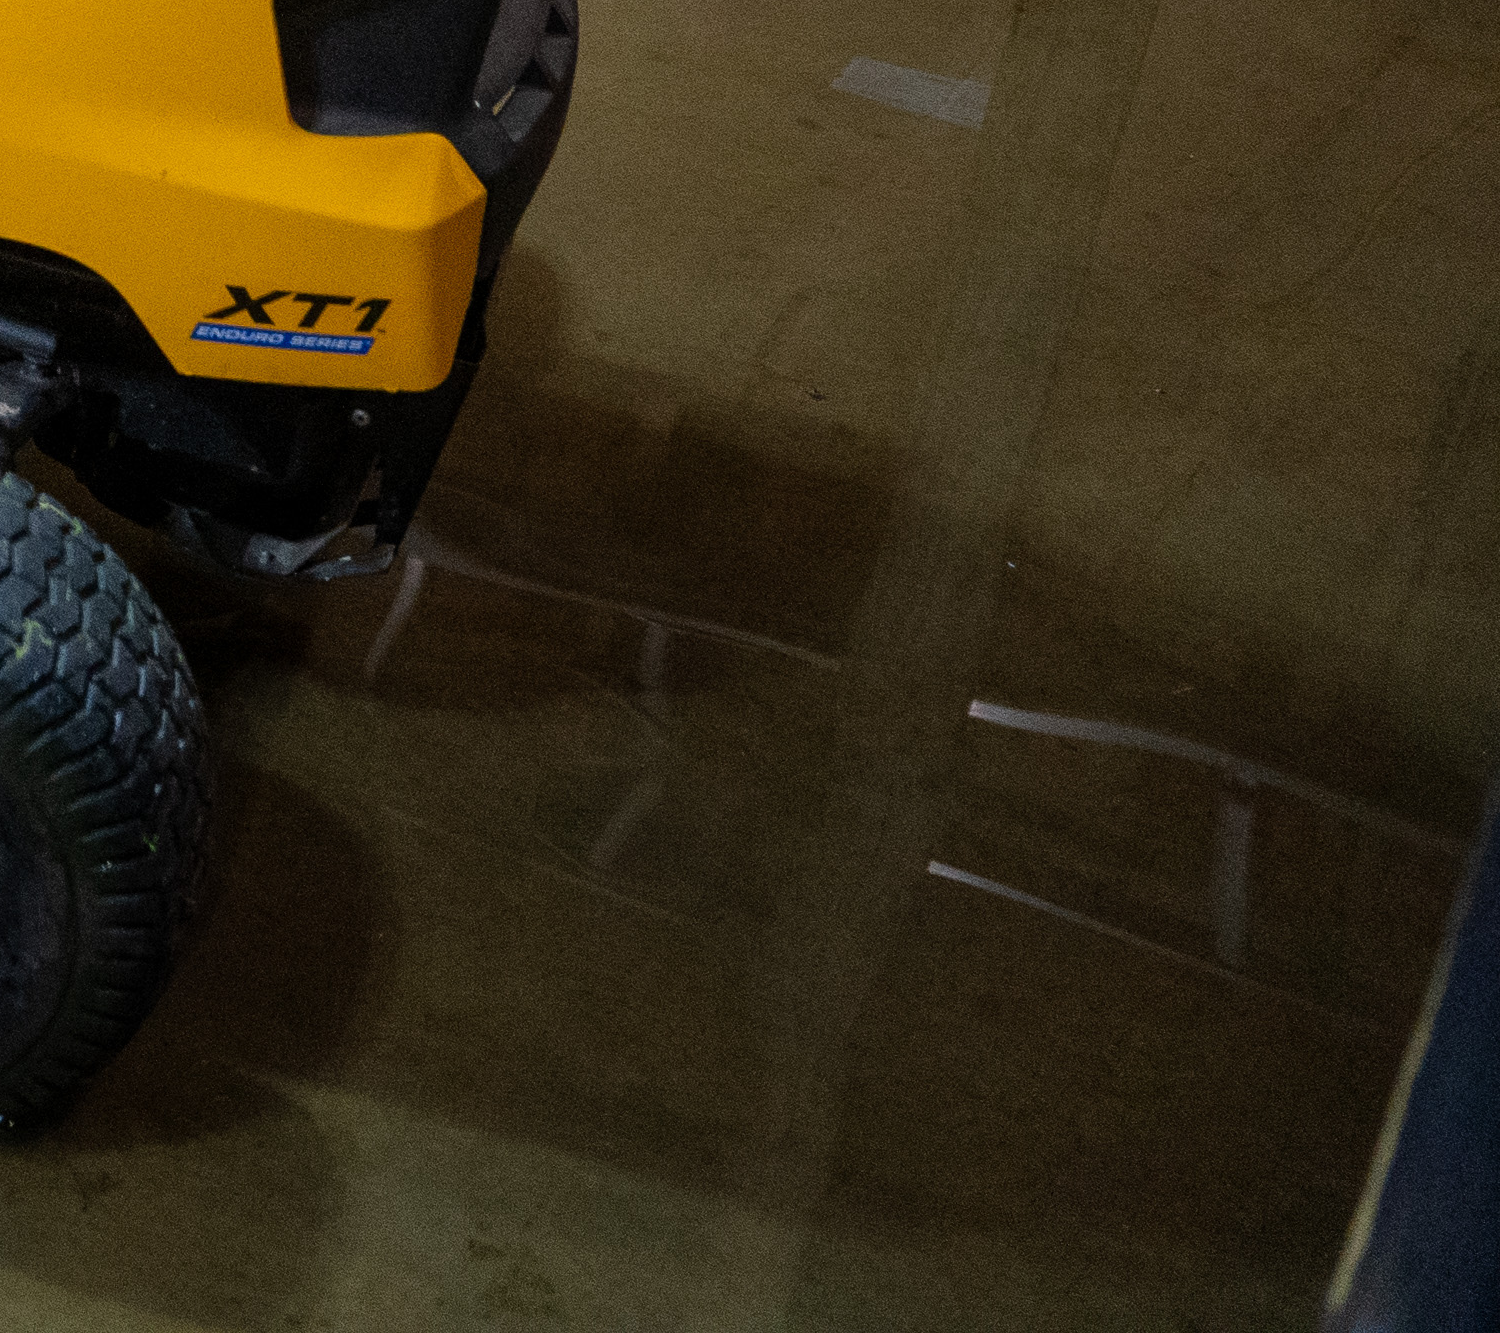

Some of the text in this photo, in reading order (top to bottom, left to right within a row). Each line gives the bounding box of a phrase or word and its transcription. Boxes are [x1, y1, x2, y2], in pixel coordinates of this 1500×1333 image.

[204, 284, 392, 333] XT1
[195, 323, 366, 352] ENDURO SERIES
